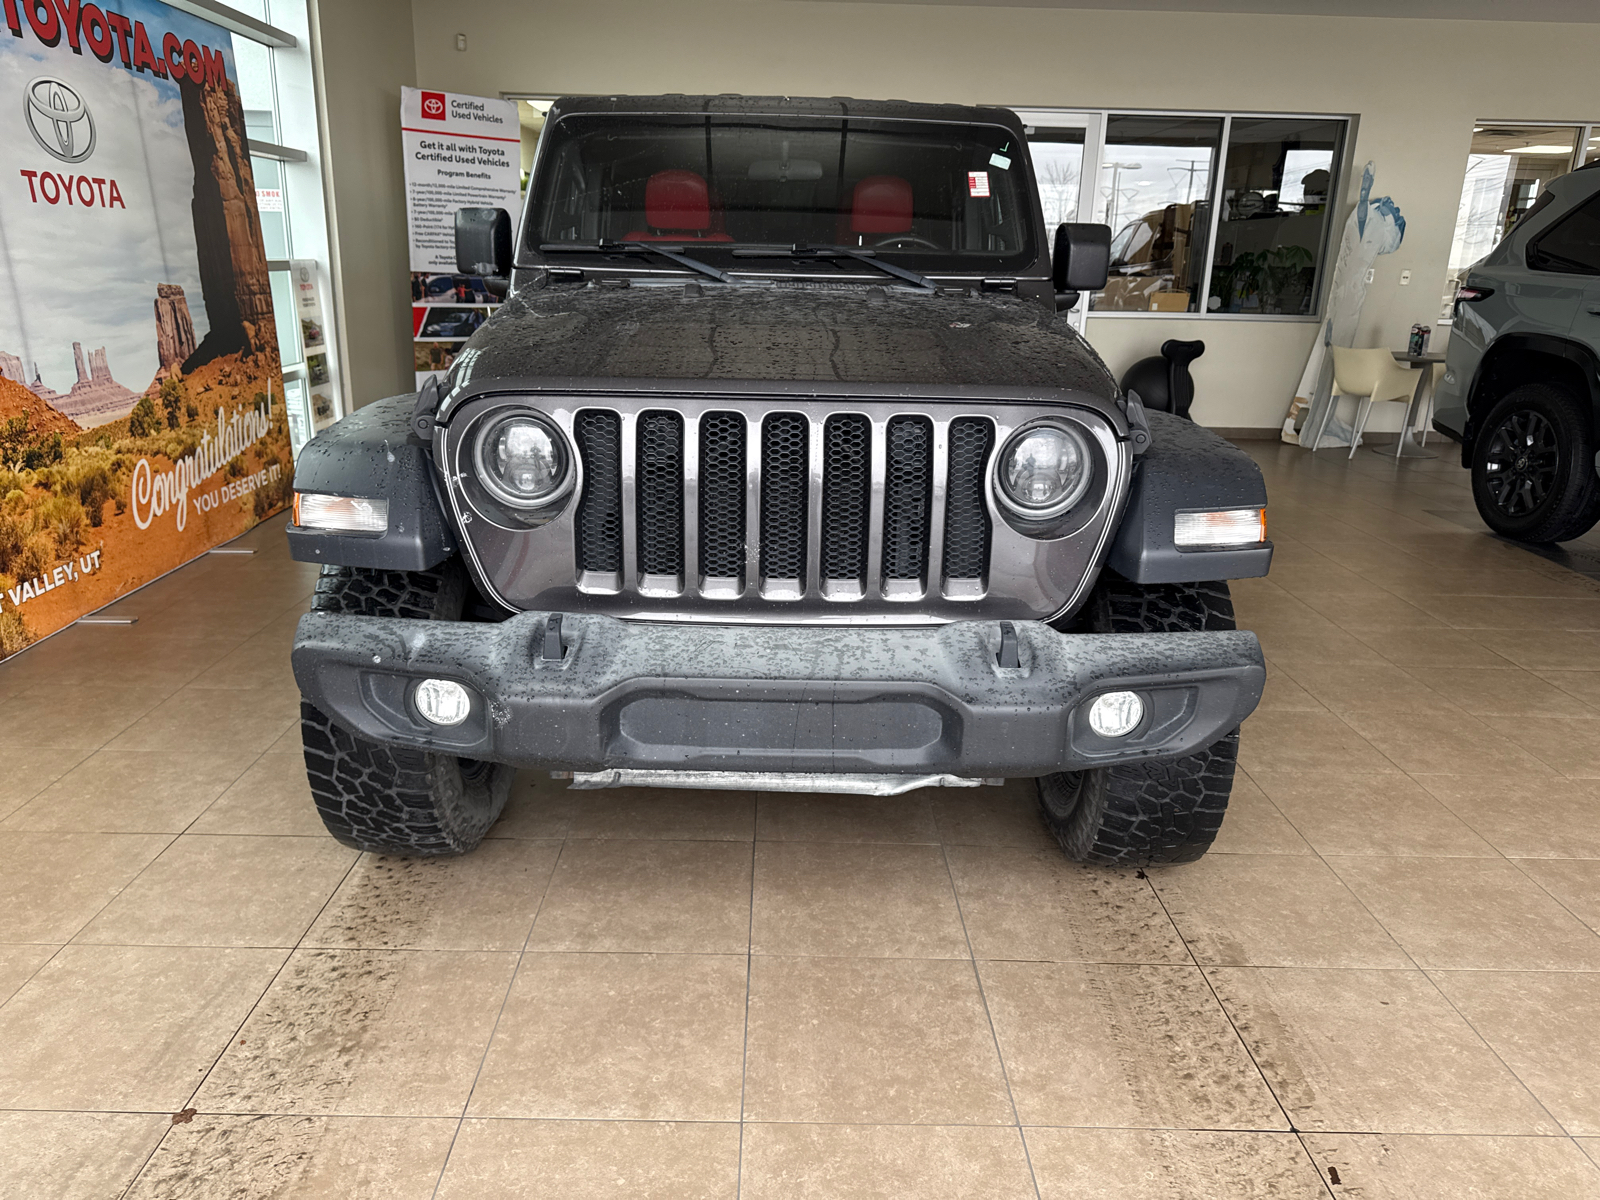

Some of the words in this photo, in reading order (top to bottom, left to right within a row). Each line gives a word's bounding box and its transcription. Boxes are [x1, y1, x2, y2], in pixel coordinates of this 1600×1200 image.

[451, 100, 485, 112] Certified
[451, 111, 471, 120] Used
[472, 113, 503, 124] Vehicles
[420, 140, 436, 150] Get
[438, 142, 444, 151] it
[446, 143, 457, 152] all
[458, 144, 477, 154] with
[479, 146, 505, 157] Toyota
[415, 152, 453, 163] Certified
[455, 155, 476, 165] Used
[477, 156, 510, 168] Vehicles
[437, 169, 465, 178] Program
[466, 171, 491, 180] Benefits
[20, 169, 126, 210] TOYOTA
[132, 377, 273, 532] Congratulations!
[193, 490, 219, 515] YOU
[221, 469, 268, 504] DESERVE
[268, 463, 282, 483] IT!
[8, 561, 79, 607] VALLEY,
[80, 550, 100, 574] UT
